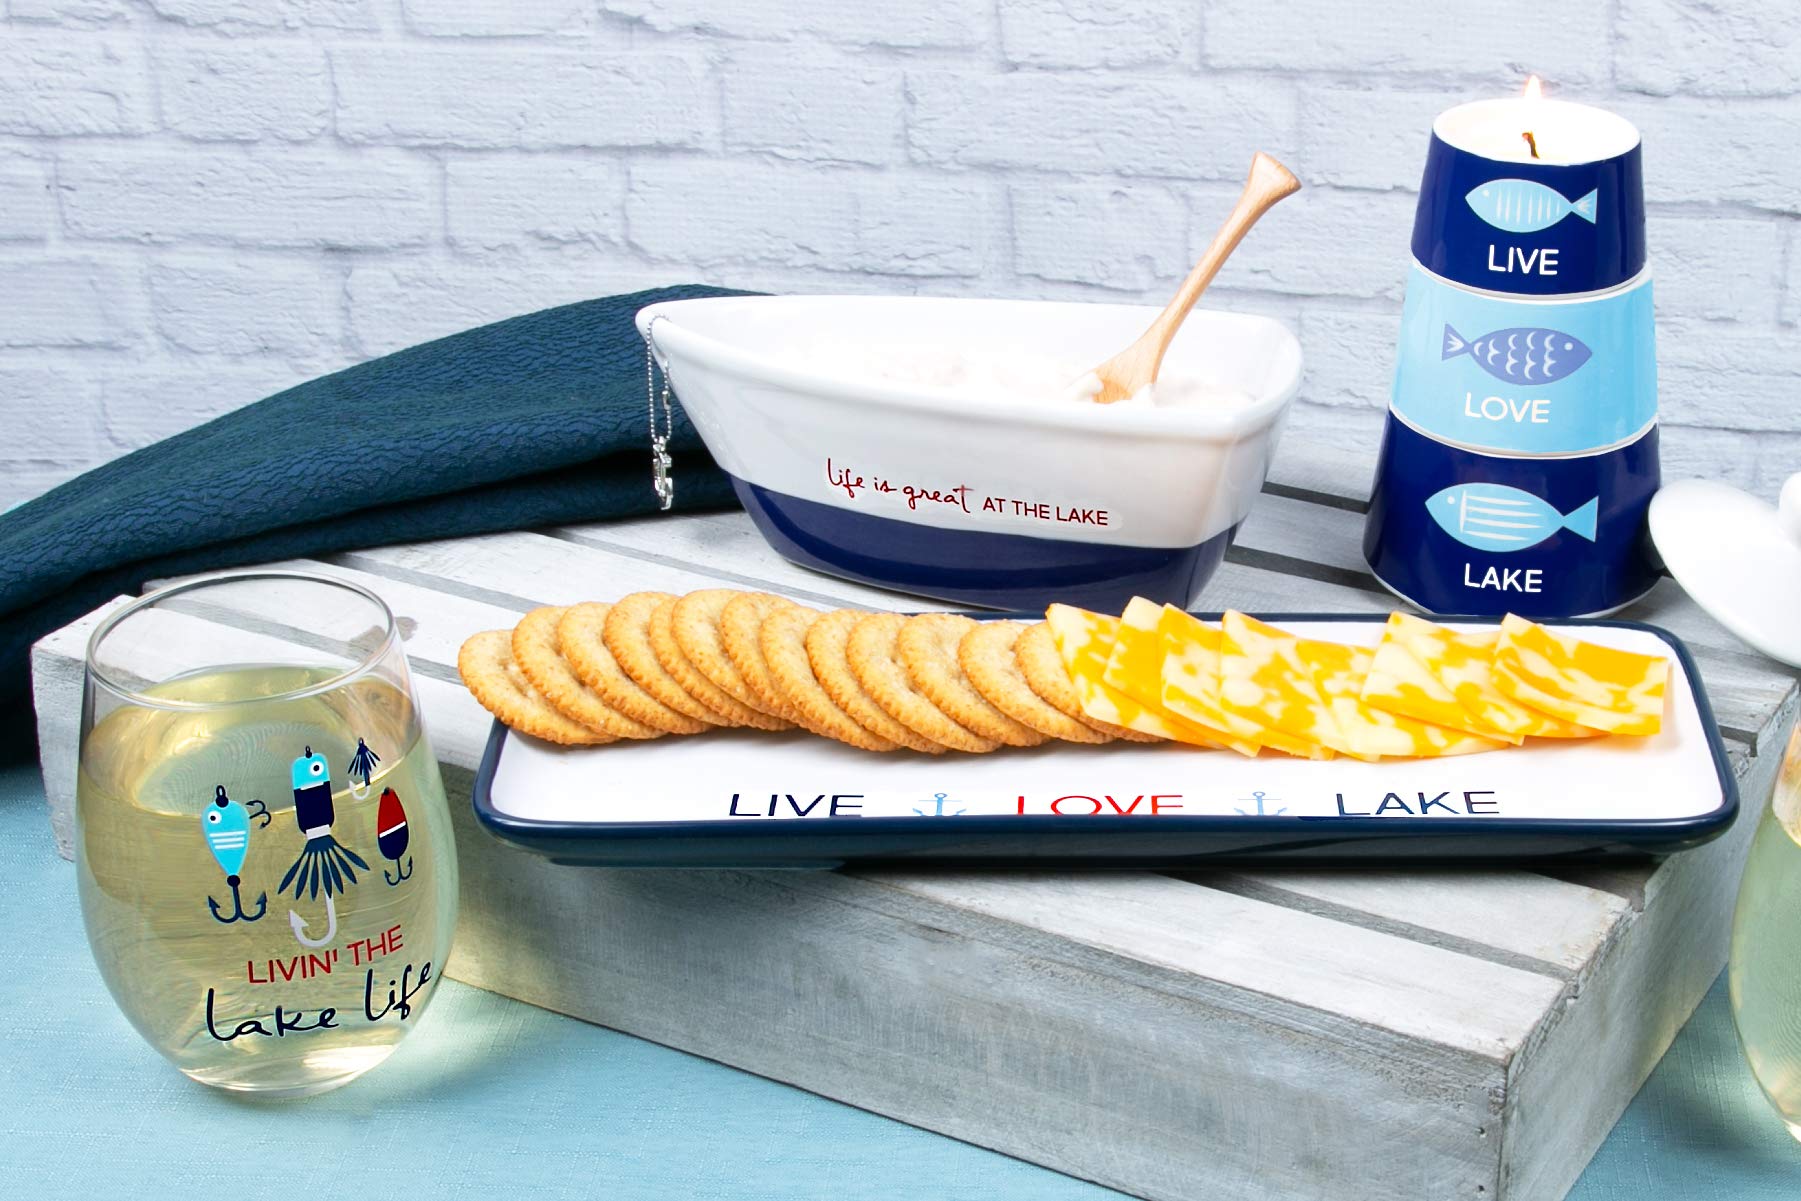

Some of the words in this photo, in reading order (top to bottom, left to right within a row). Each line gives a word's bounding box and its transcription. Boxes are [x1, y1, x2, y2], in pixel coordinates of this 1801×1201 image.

[1487, 244, 1560, 277] LIVE
[1464, 391, 1551, 425] LOVE
[873, 476, 898, 493] is
[902, 484, 976, 514] great
[982, 496, 1007, 513] AT
[1011, 500, 1051, 520] THE
[1056, 506, 1109, 526] LAKE
[1463, 562, 1544, 594] LAKE
[728, 793, 865, 818] LIVE
[1016, 794, 1184, 816] LOVE
[1335, 790, 1501, 817] LAKE
[247, 948, 339, 985] LIVIN'
[346, 923, 404, 967] THE
